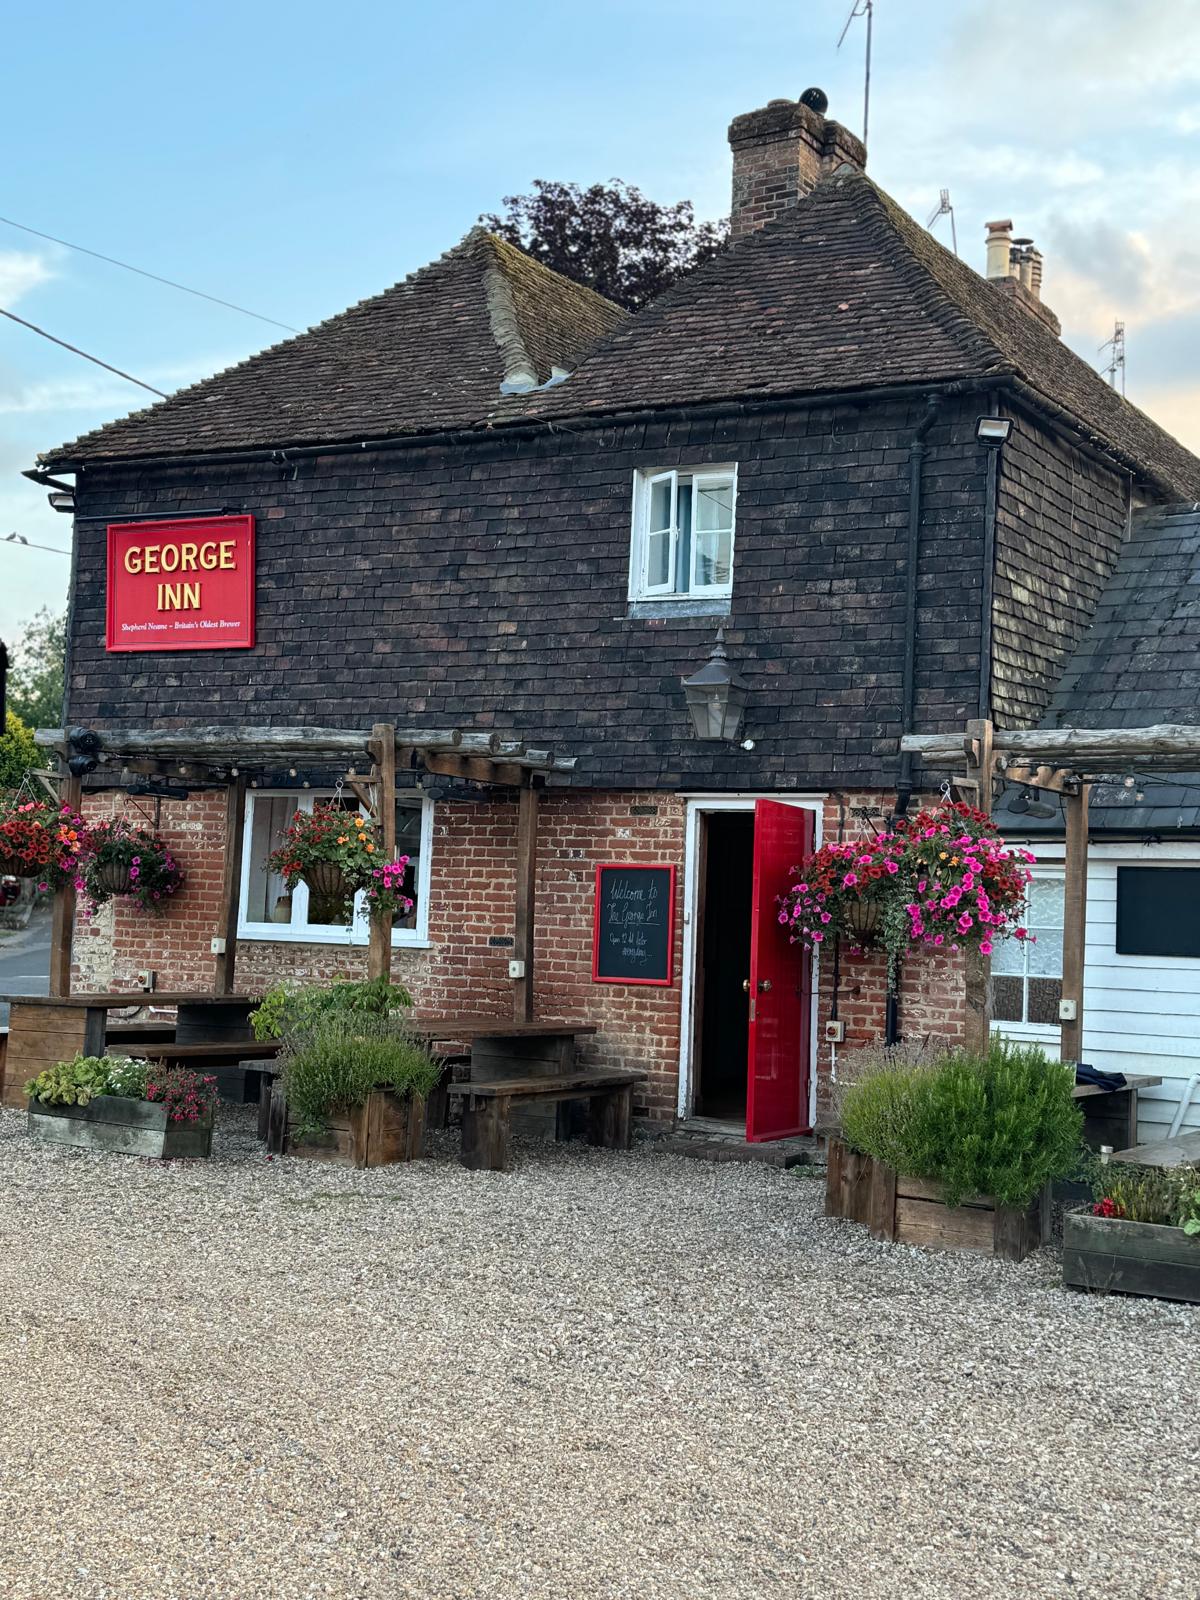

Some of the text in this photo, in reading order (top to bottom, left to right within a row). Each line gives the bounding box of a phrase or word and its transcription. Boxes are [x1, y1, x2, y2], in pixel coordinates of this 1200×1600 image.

[124, 540, 237, 574] GEORGE
[156, 582, 201, 612] INN
[121, 623, 147, 632] Shepherd
[148, 622, 168, 630] Neame
[174, 621, 198, 629] Britain's
[200, 620, 218, 628] Oldest
[219, 620, 240, 628] Brewer
[611, 879, 658, 901] Welcome to
